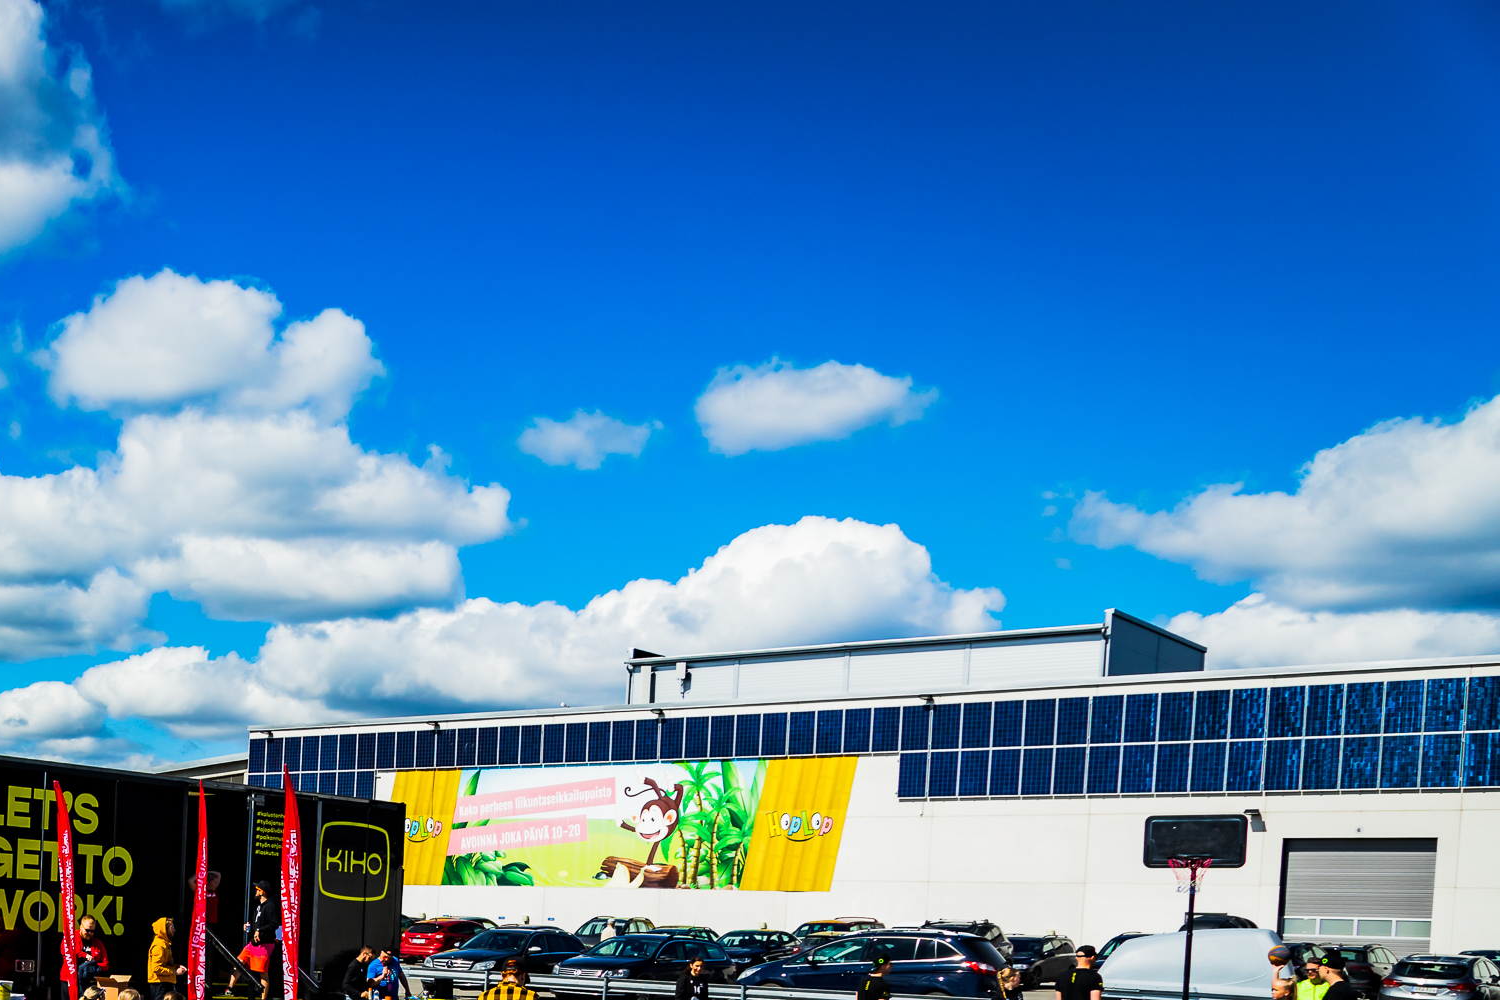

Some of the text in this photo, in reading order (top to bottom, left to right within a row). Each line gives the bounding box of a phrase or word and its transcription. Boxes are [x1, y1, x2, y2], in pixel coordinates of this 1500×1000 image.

[459, 787, 612, 817] Koko perheen liikuntaseikkailupuisto
[461, 833, 498, 849] AVOINNA
[500, 829, 522, 845] JOKA
[524, 824, 549, 841] PÄIVÄ
[77, 843, 133, 887] TO
[326, 848, 382, 875] KIHO
